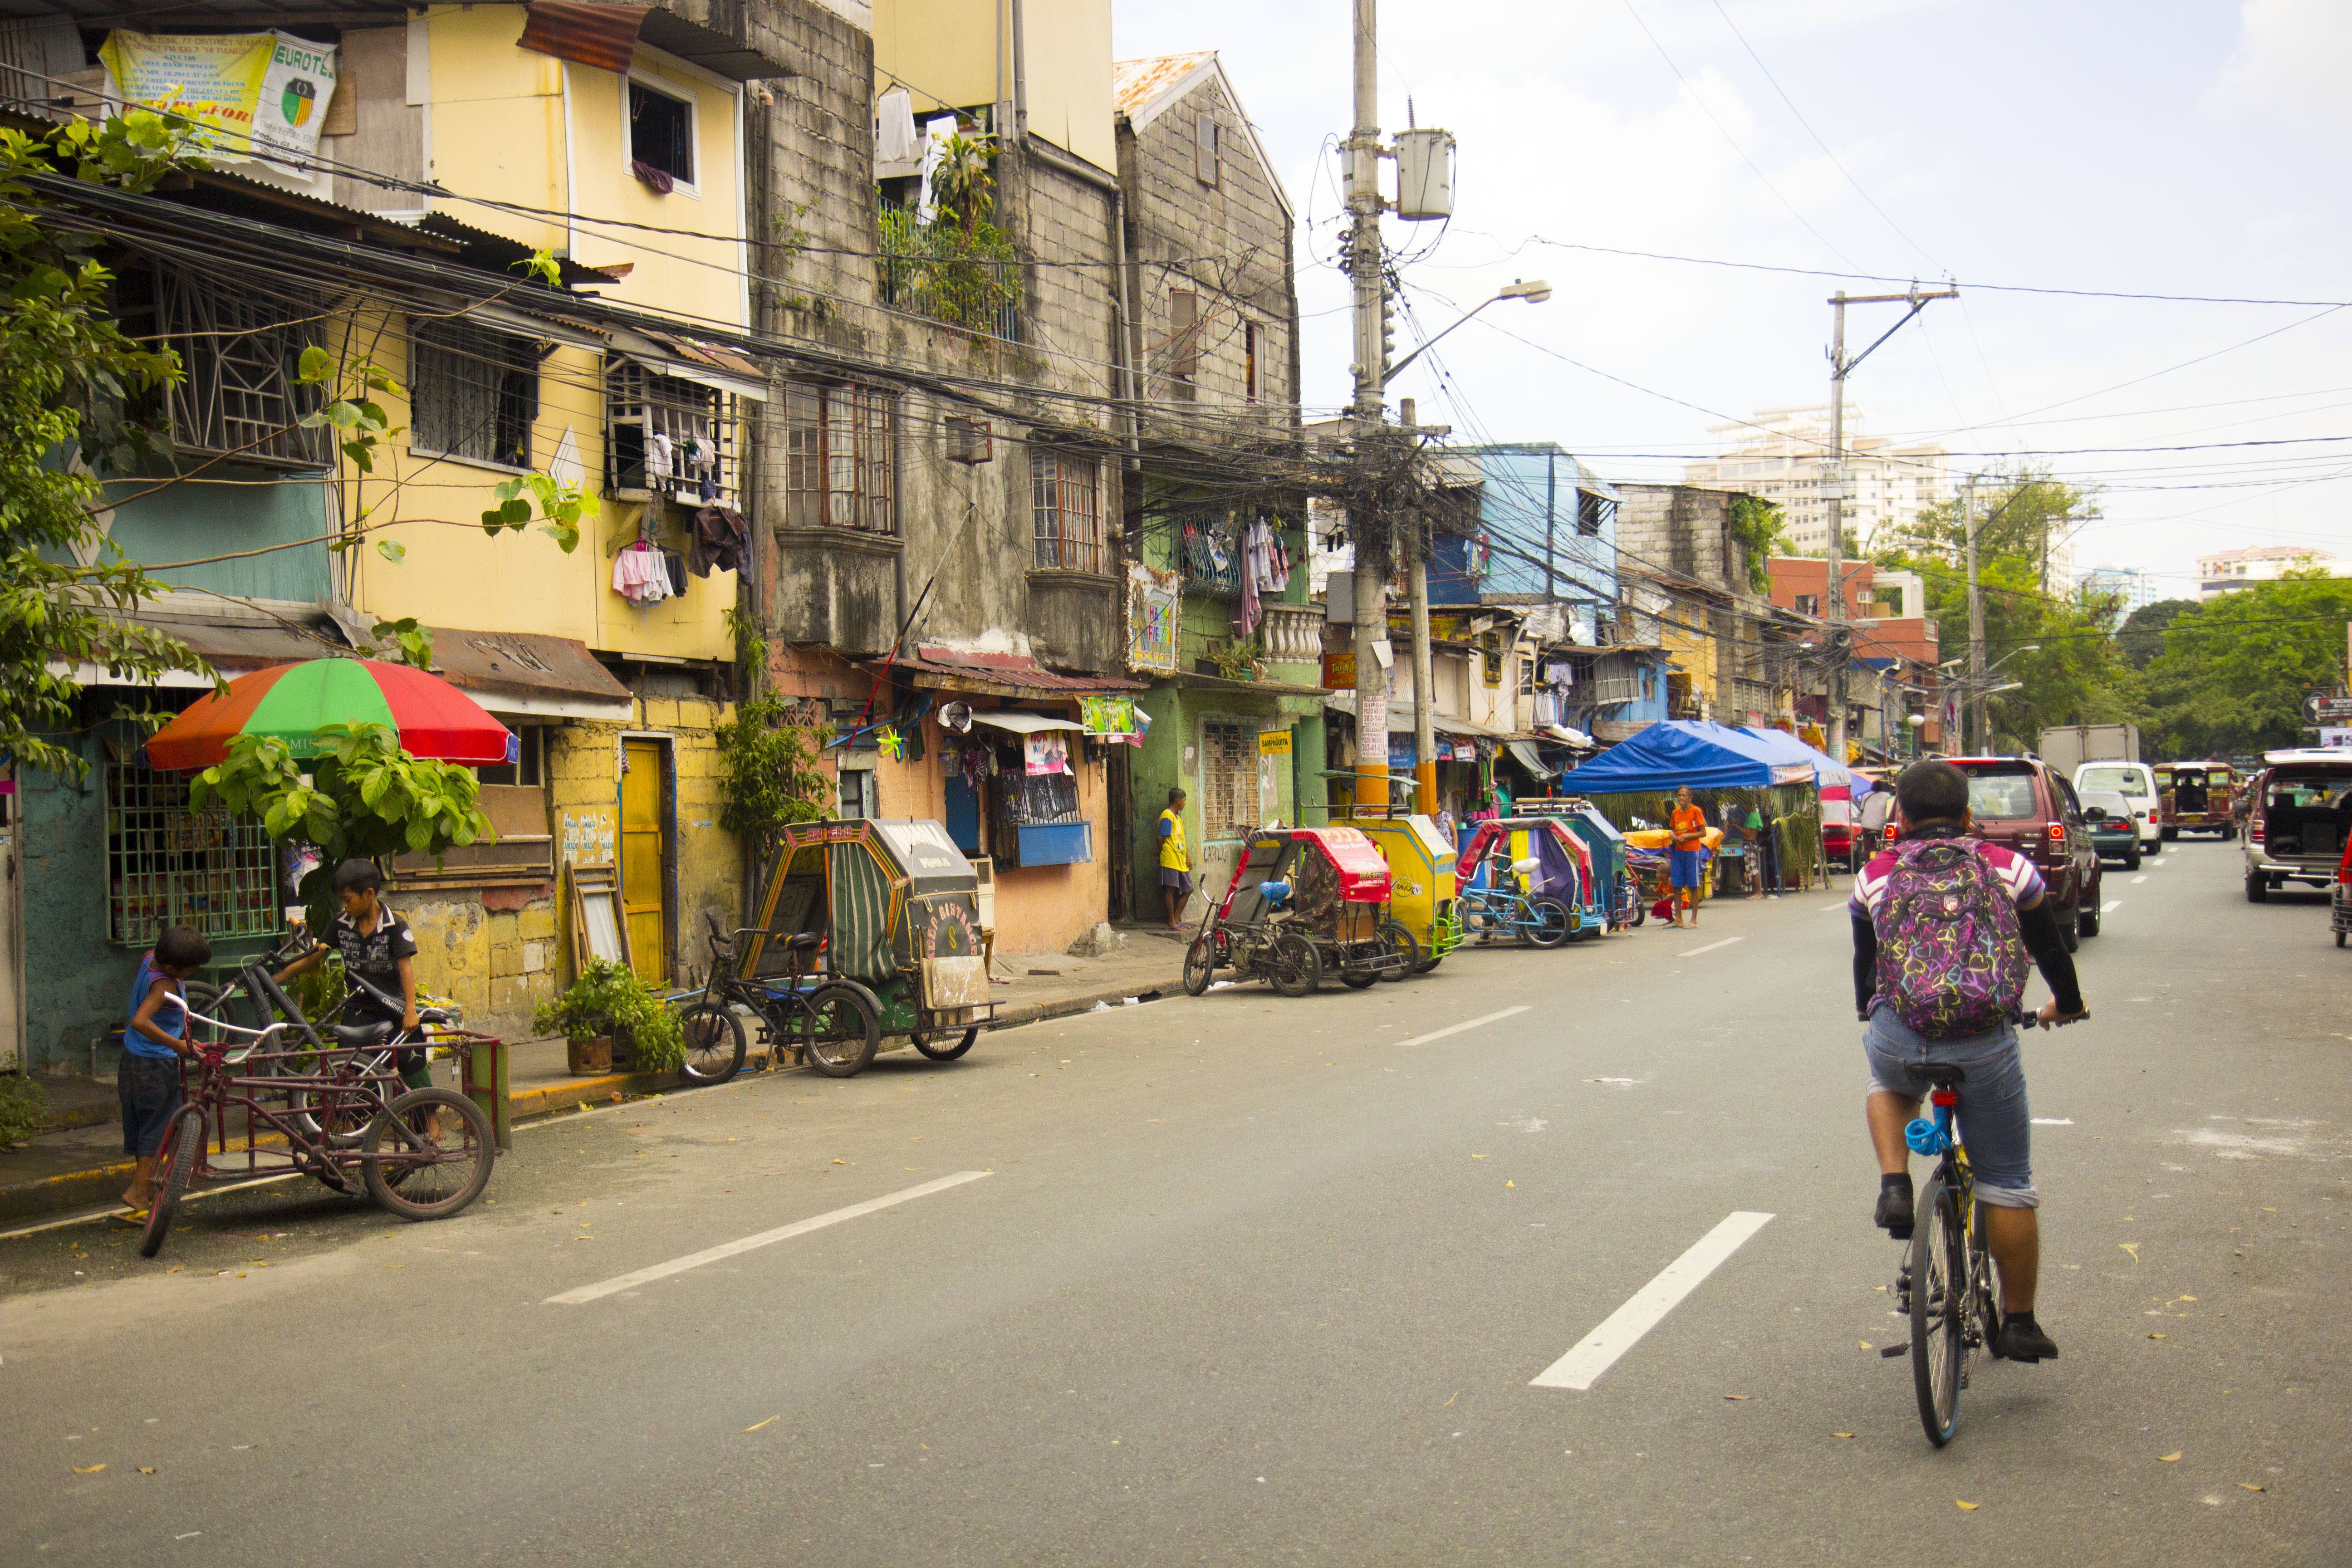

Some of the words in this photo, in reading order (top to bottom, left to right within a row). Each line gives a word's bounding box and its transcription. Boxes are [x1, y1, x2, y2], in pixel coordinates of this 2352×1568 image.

[1148, 603, 1171, 625] HAPPY
[1148, 624, 1172, 645] FIESTA
[1262, 738, 1288, 748] SAMPAGUITA
[806, 824, 853, 842] ANELO
[1391, 880, 1420, 895] LAKERS
[927, 916, 938, 960] KEEP
[938, 902, 978, 956] DISTANCE
